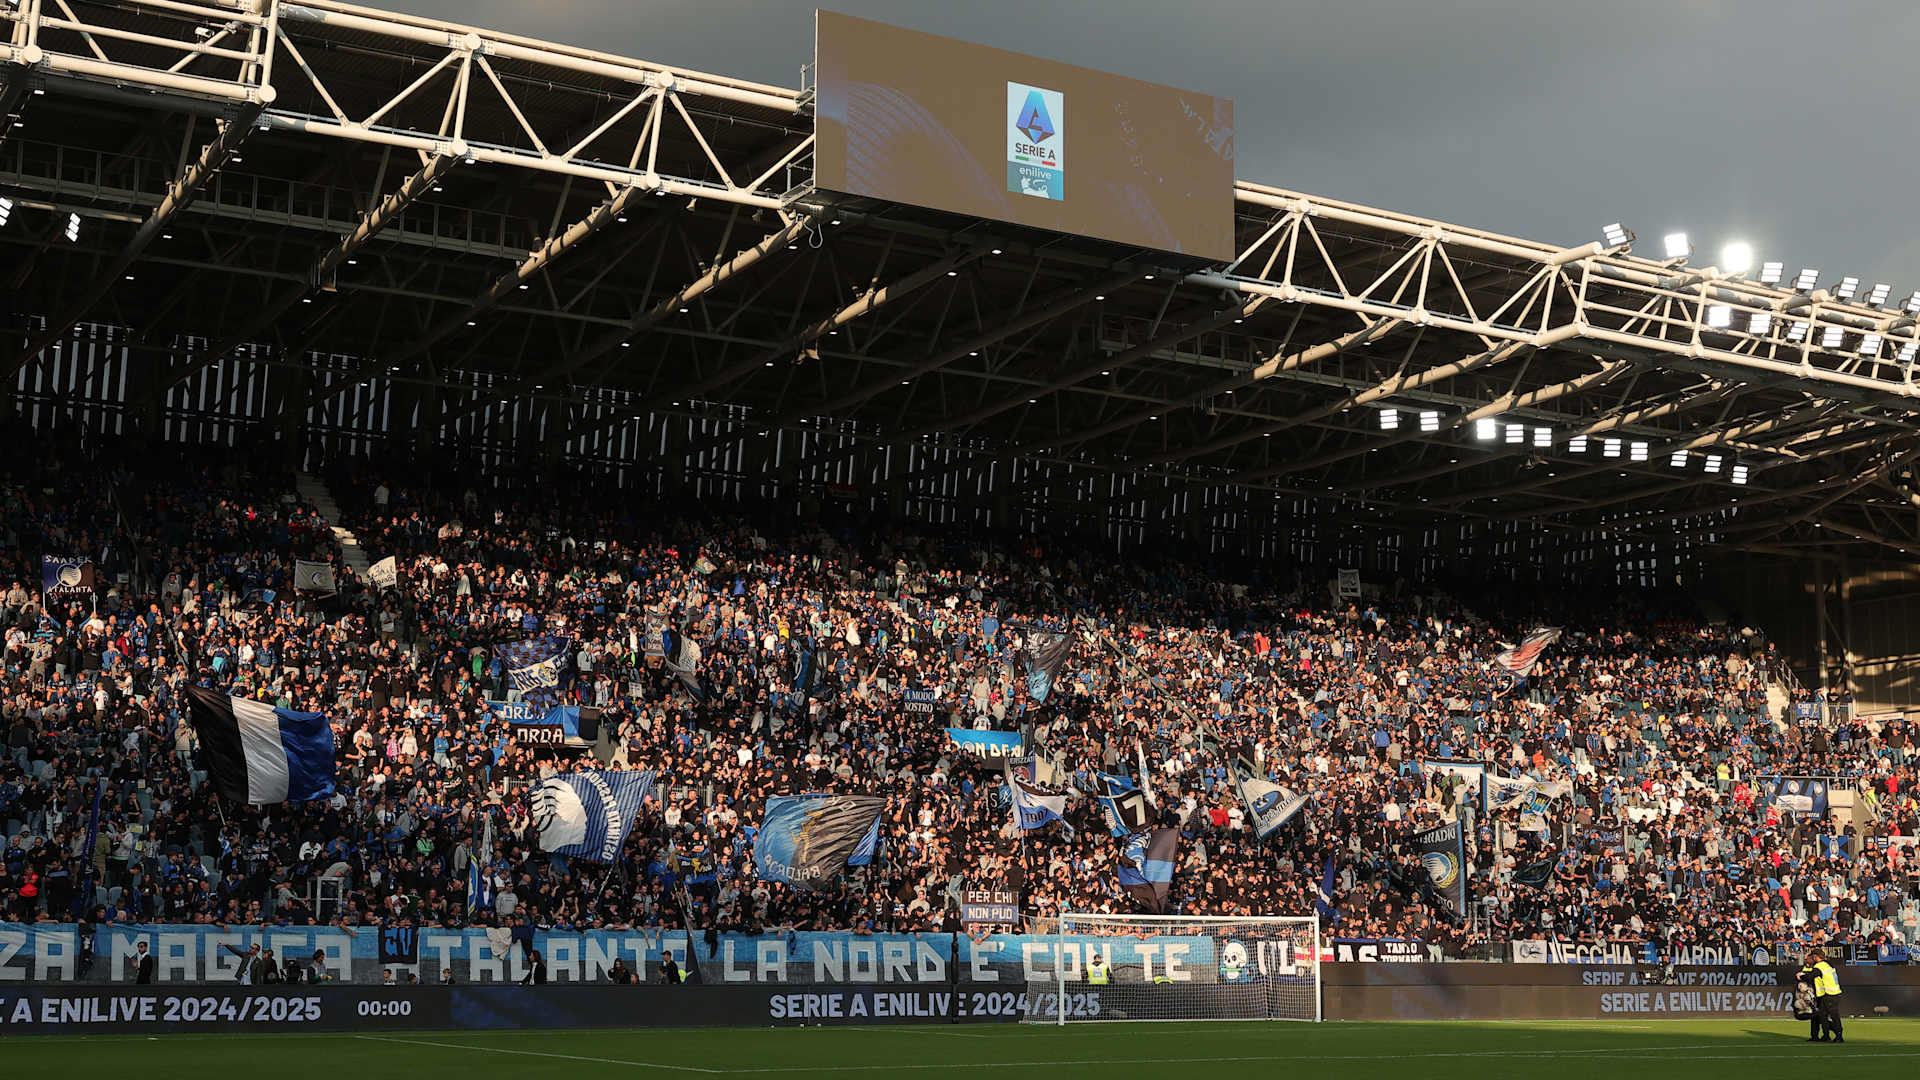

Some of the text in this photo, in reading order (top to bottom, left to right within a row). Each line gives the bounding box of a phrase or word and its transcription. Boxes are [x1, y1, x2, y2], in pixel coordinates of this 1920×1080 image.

[1015, 143, 1056, 160] SERIE A
[1019, 166, 1052, 180] enilive
[912, 691, 934, 700] MODO
[904, 702, 934, 713] NOSTRO
[517, 728, 564, 743] ORDA
[968, 891, 1012, 903] PER CHI
[968, 907, 989, 919] NON
[723, 940, 788, 982] LA
[814, 940, 946, 982] NORD
[1022, 943, 1112, 982] CON
[1134, 943, 1192, 982] TE
[1701, 972, 1777, 986] 2024/2025
[10, 998, 33, 1023] A
[41, 997, 157, 1022] ENILIVE
[164, 996, 322, 1022] 2024/2025
[357, 1000, 412, 1016] 00:00
[770, 993, 844, 1018] SERIE
[850, 993, 868, 1018] A
[972, 992, 1100, 1016] 2024/2025
[1601, 993, 1650, 1012] SERIE
[1654, 993, 1666, 1011] A
[1670, 992, 1733, 1012] ENILIVE
